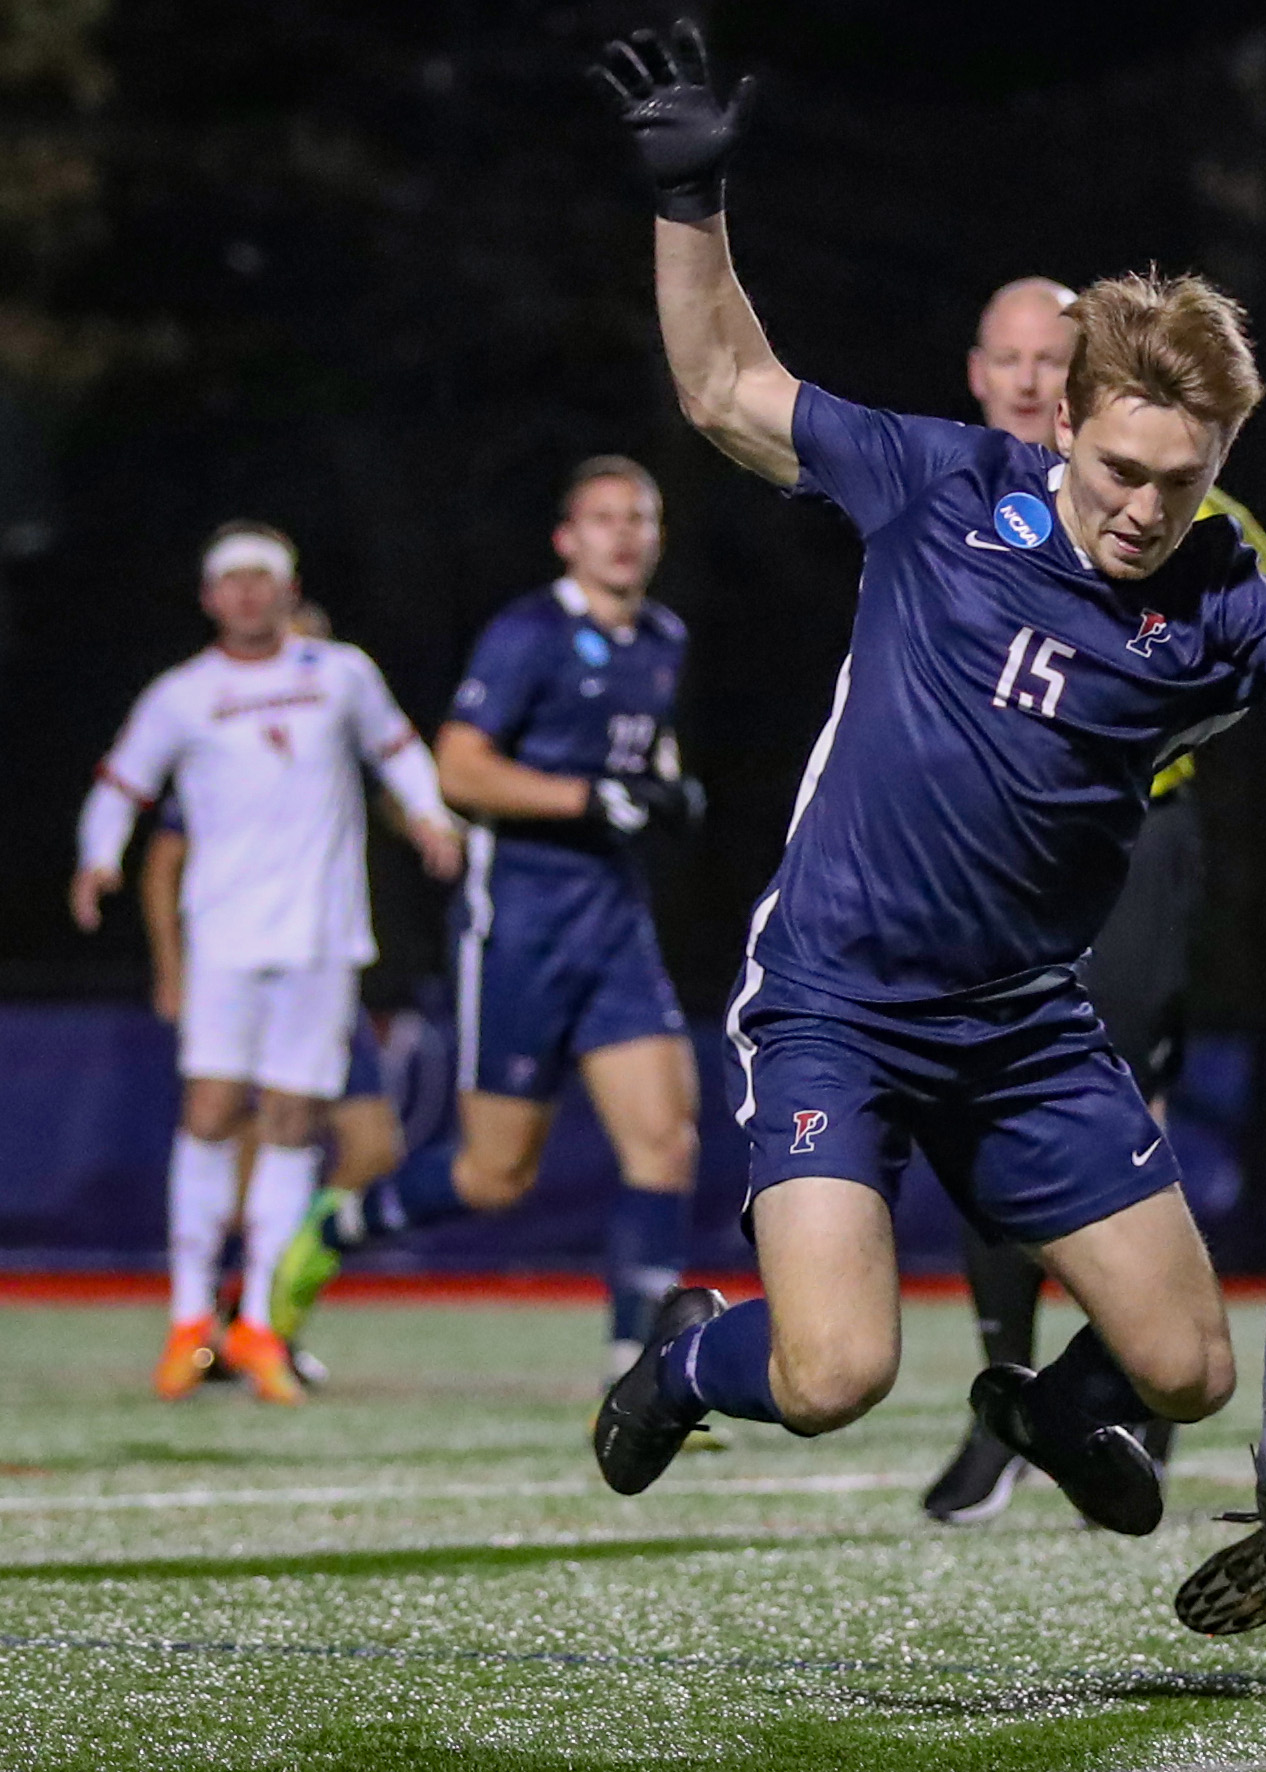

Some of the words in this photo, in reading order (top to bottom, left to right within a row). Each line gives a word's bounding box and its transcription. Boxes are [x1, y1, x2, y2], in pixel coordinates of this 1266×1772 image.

[1000, 505, 1038, 546] NCAA
[1126, 608, 1171, 658] P
[992, 626, 1077, 718] 15
[789, 1109, 828, 1154] P
